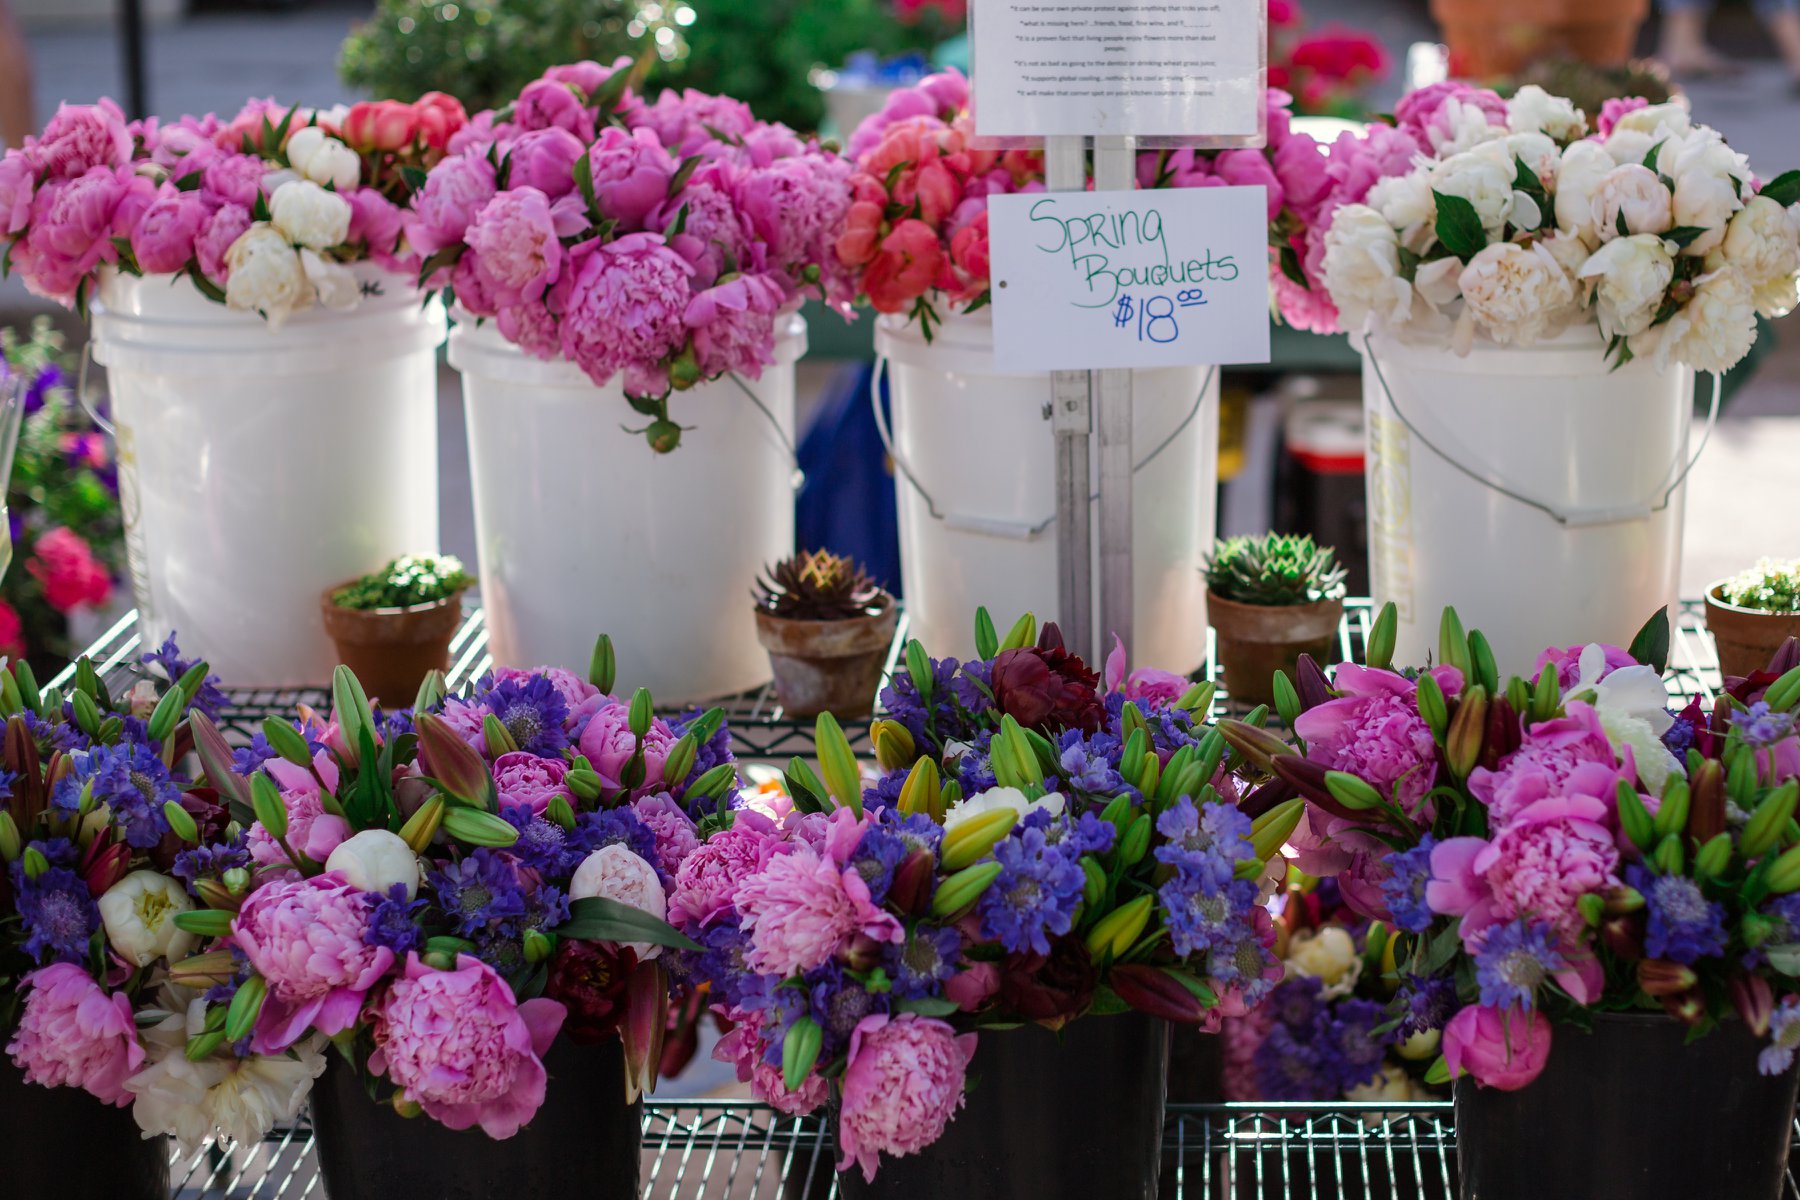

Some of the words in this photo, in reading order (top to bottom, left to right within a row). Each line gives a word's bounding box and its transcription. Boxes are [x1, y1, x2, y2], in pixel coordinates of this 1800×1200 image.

[1071, 5, 1092, 13] private
[1093, 5, 1116, 13] protest
[1117, 5, 1139, 13] against
[1140, 5, 1167, 13] anything
[1046, 20, 1069, 28] missing
[1086, 35, 1102, 43] living
[1103, 35, 1124, 43] people
[1125, 35, 1142, 43] enjoy
[1069, 60, 1086, 68] going
[1137, 60, 1162, 68] drinking
[1031, 75, 1057, 83] supports
[1058, 75, 1077, 83] global
[1091, 90, 1105, 98] spot
